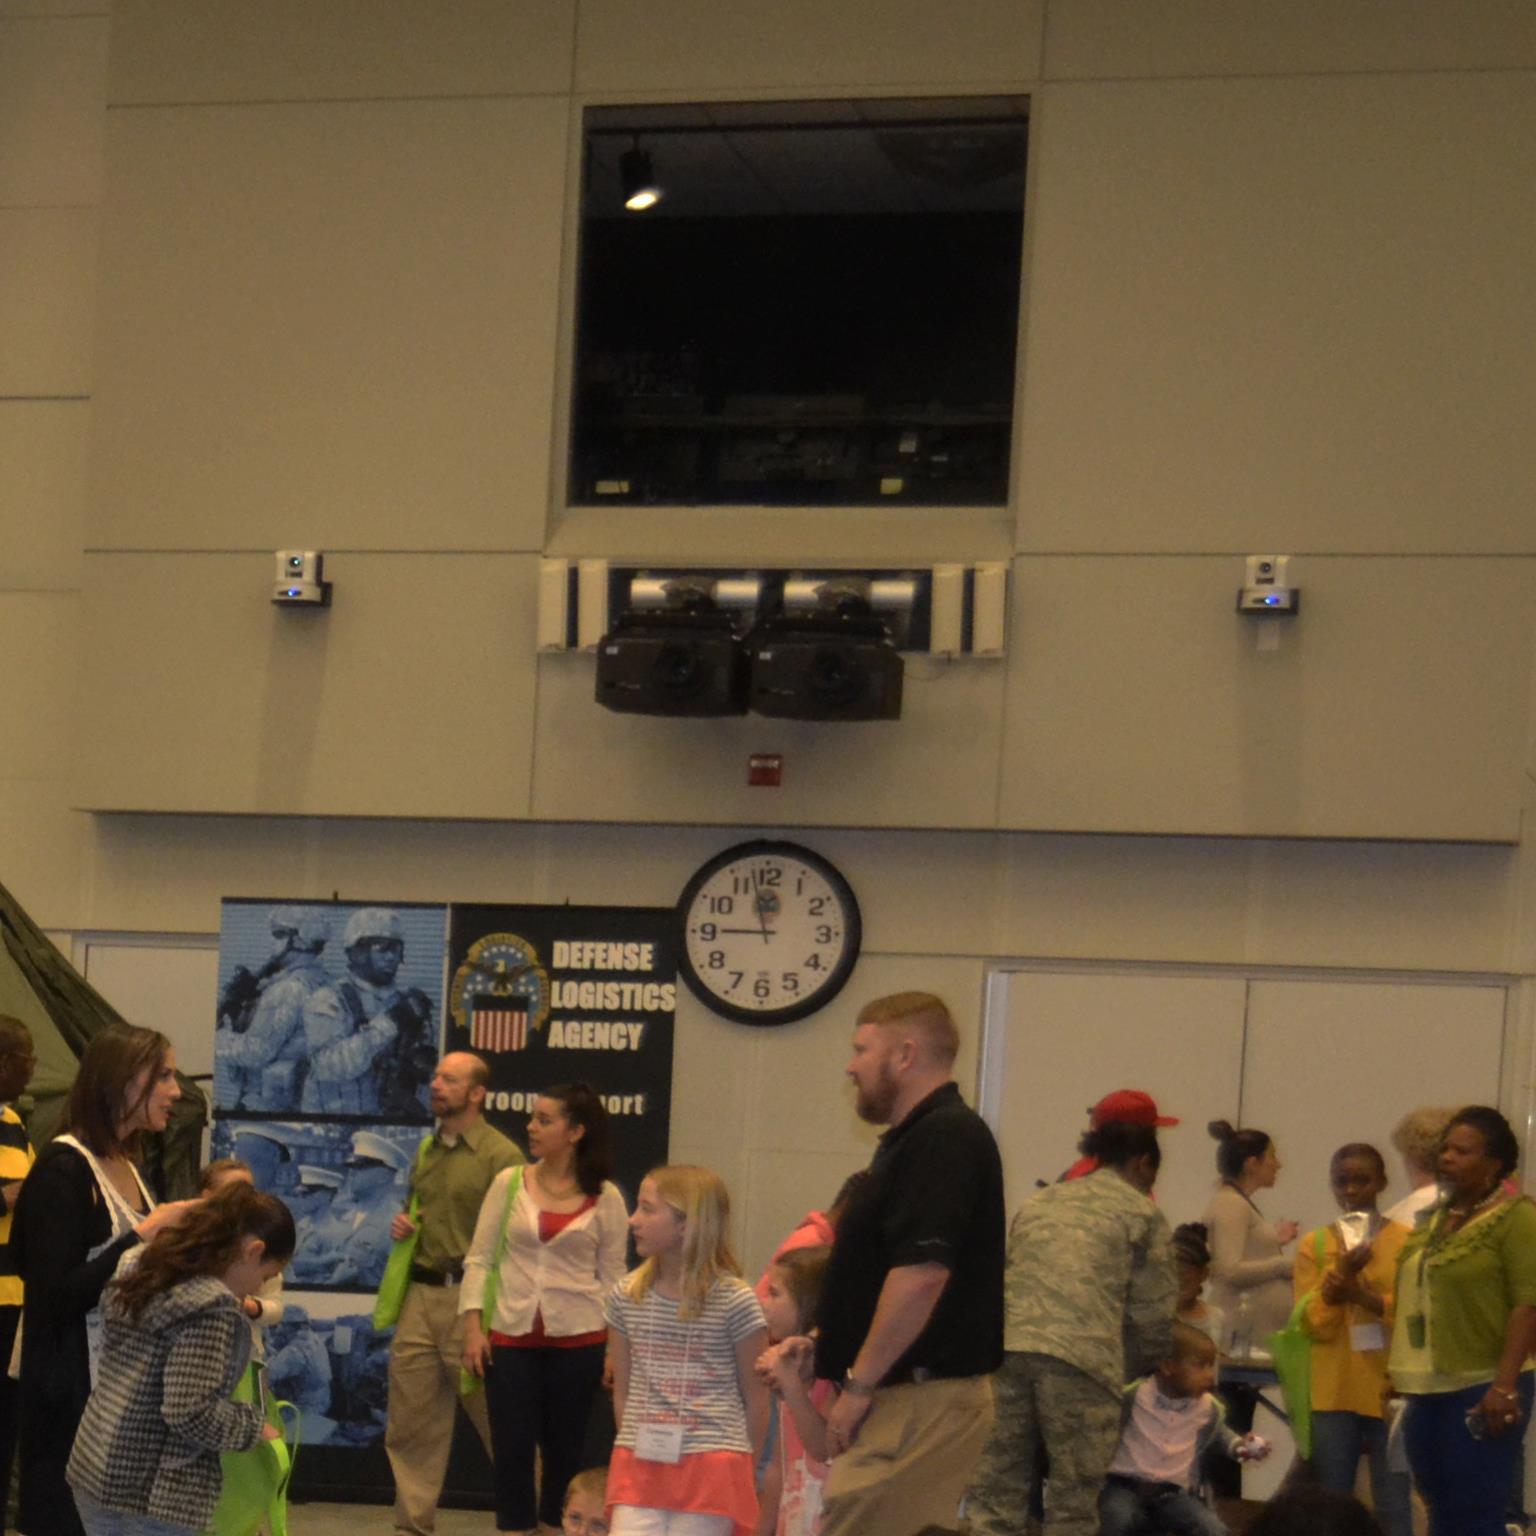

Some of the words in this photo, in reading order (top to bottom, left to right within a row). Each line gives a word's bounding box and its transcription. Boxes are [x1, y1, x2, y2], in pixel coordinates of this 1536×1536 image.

[733, 877, 749, 895] 11
[759, 868, 781, 887] 12
[796, 877, 803, 896] 1
[710, 896, 733, 915] 10
[808, 898, 824, 916] 2
[700, 923, 716, 942] 9
[815, 925, 832, 944] 3
[552, 940, 654, 971] DEFENSE
[708, 951, 725, 969] 8
[804, 954, 820, 971] 4
[728, 971, 744, 990] 7
[754, 979, 770, 998] 6
[782, 973, 799, 991] 5
[550, 981, 676, 1012] LOGISTICS
[547, 1020, 645, 1051] AGENCY
[485, 1091, 538, 1114] roop
